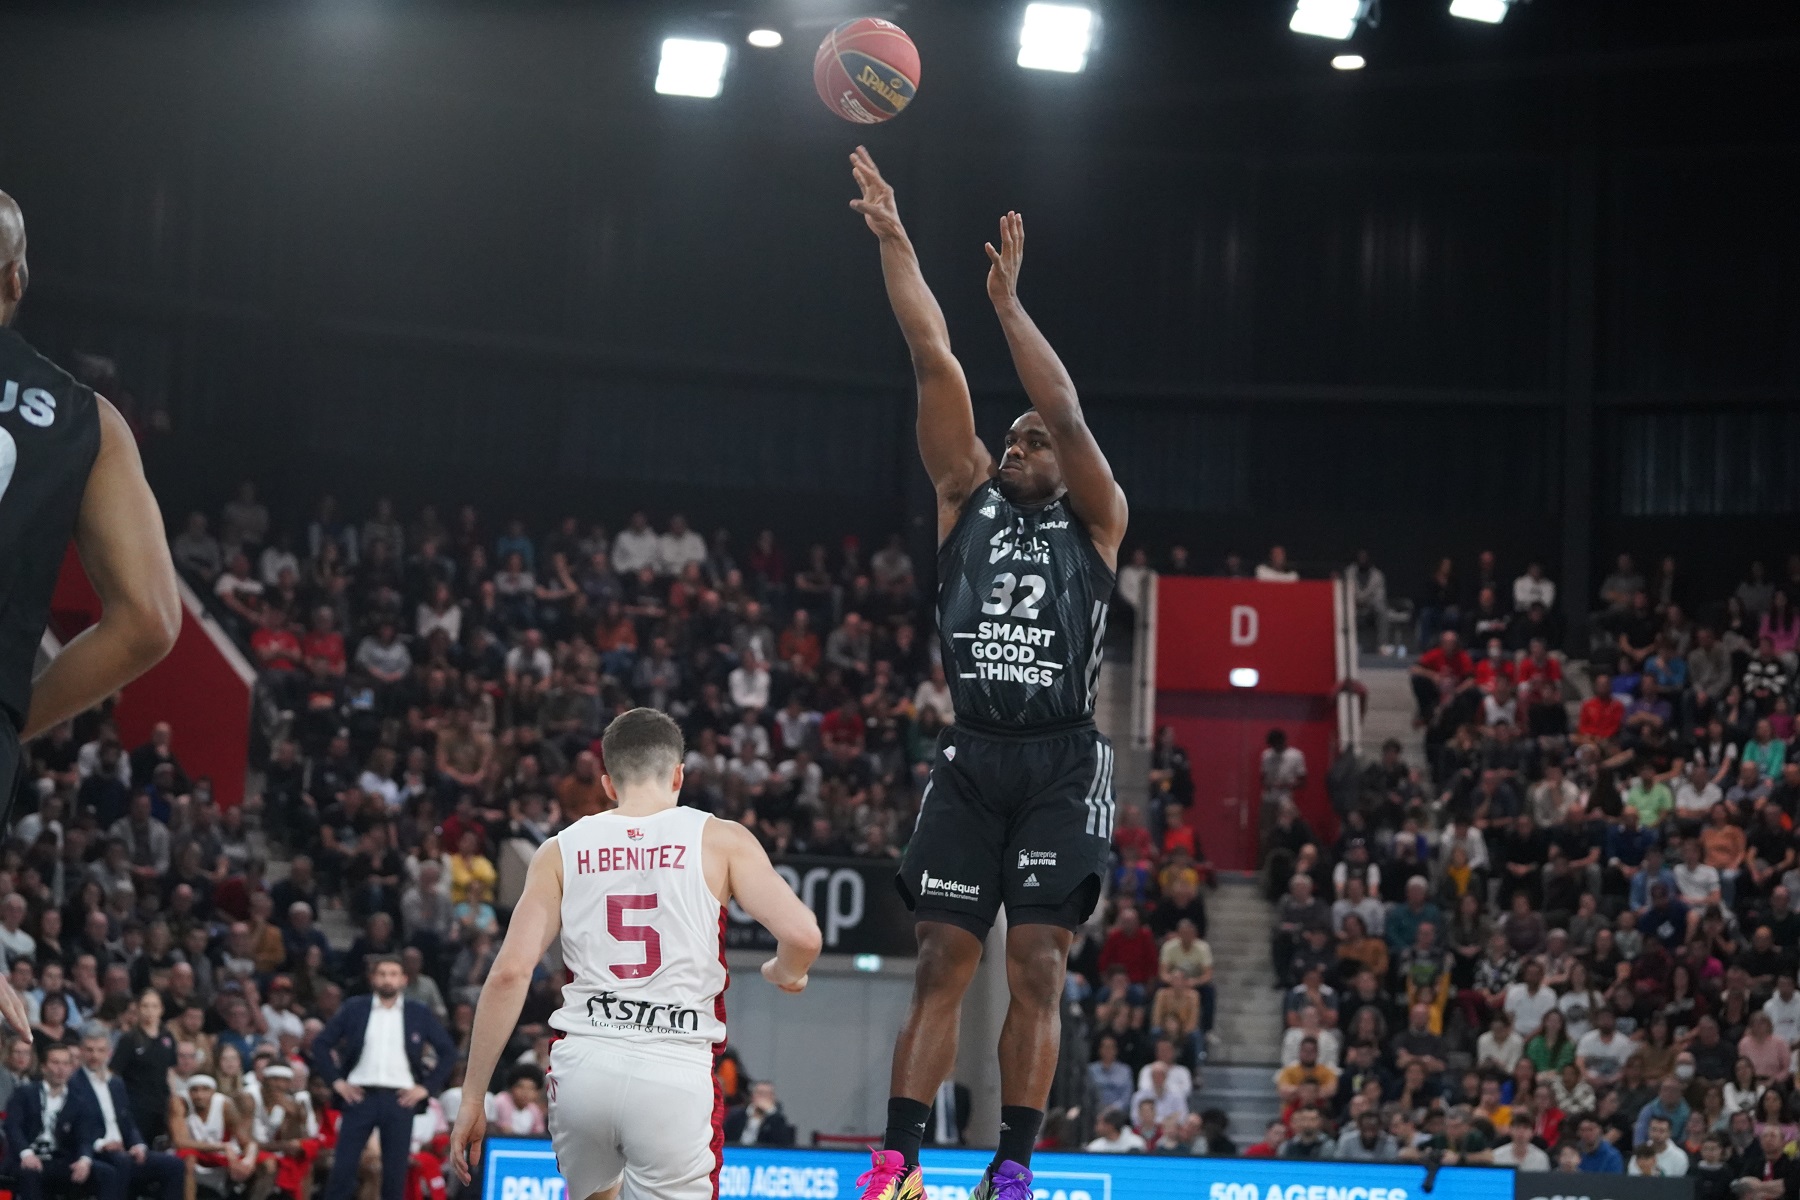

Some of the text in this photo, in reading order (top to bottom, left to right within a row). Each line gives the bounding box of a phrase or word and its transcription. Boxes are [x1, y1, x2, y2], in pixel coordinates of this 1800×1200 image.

[981, 572, 1047, 620] 32
[977, 622, 1056, 648] SMART
[1231, 605, 1259, 646] D
[971, 642, 1035, 663] GOOD
[975, 662, 1053, 687] THINGS
[935, 879, 980, 895] Adéquat
[605, 892, 662, 981] 5
